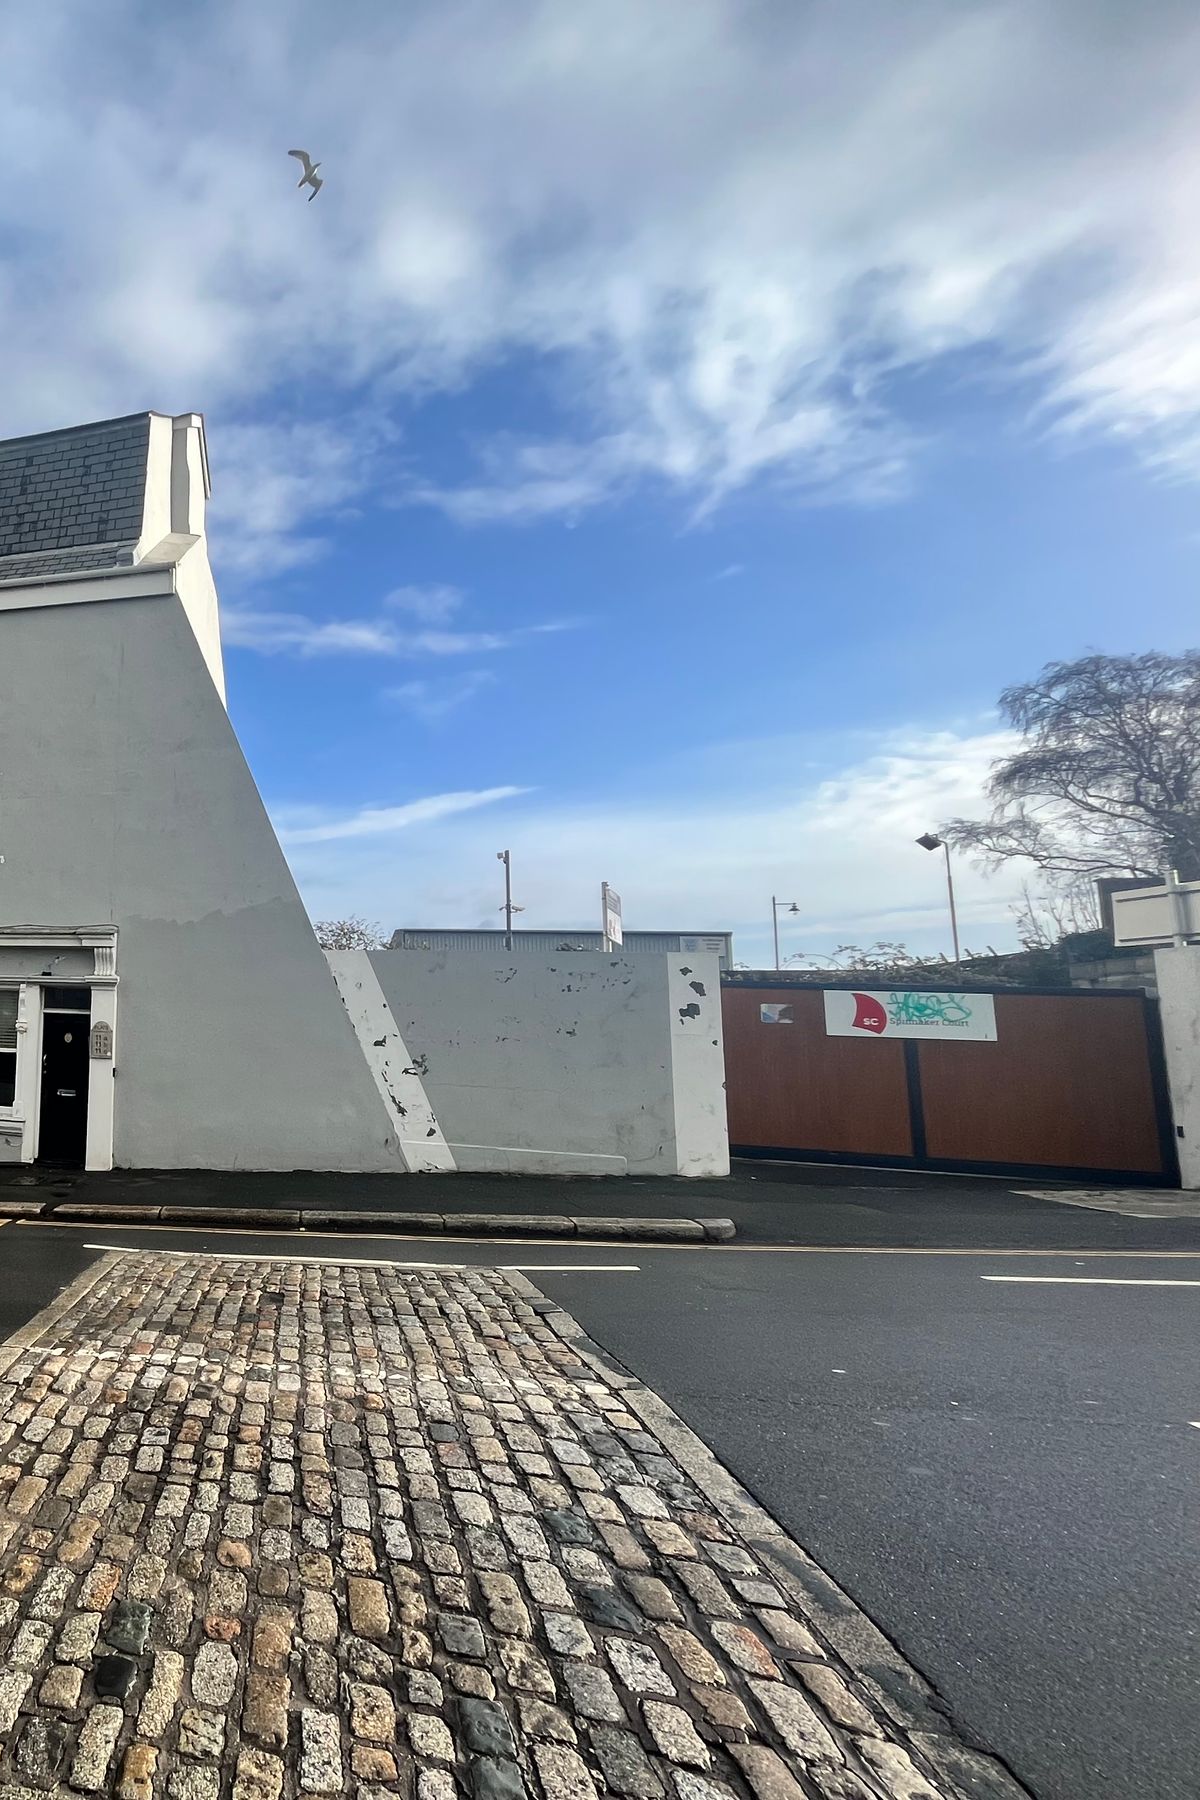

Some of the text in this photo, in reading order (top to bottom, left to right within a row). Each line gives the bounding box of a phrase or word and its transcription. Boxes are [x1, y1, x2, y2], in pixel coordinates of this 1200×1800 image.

[863, 1017, 879, 1026] SC
[889, 1017, 969, 1027] Spinnaker Court
